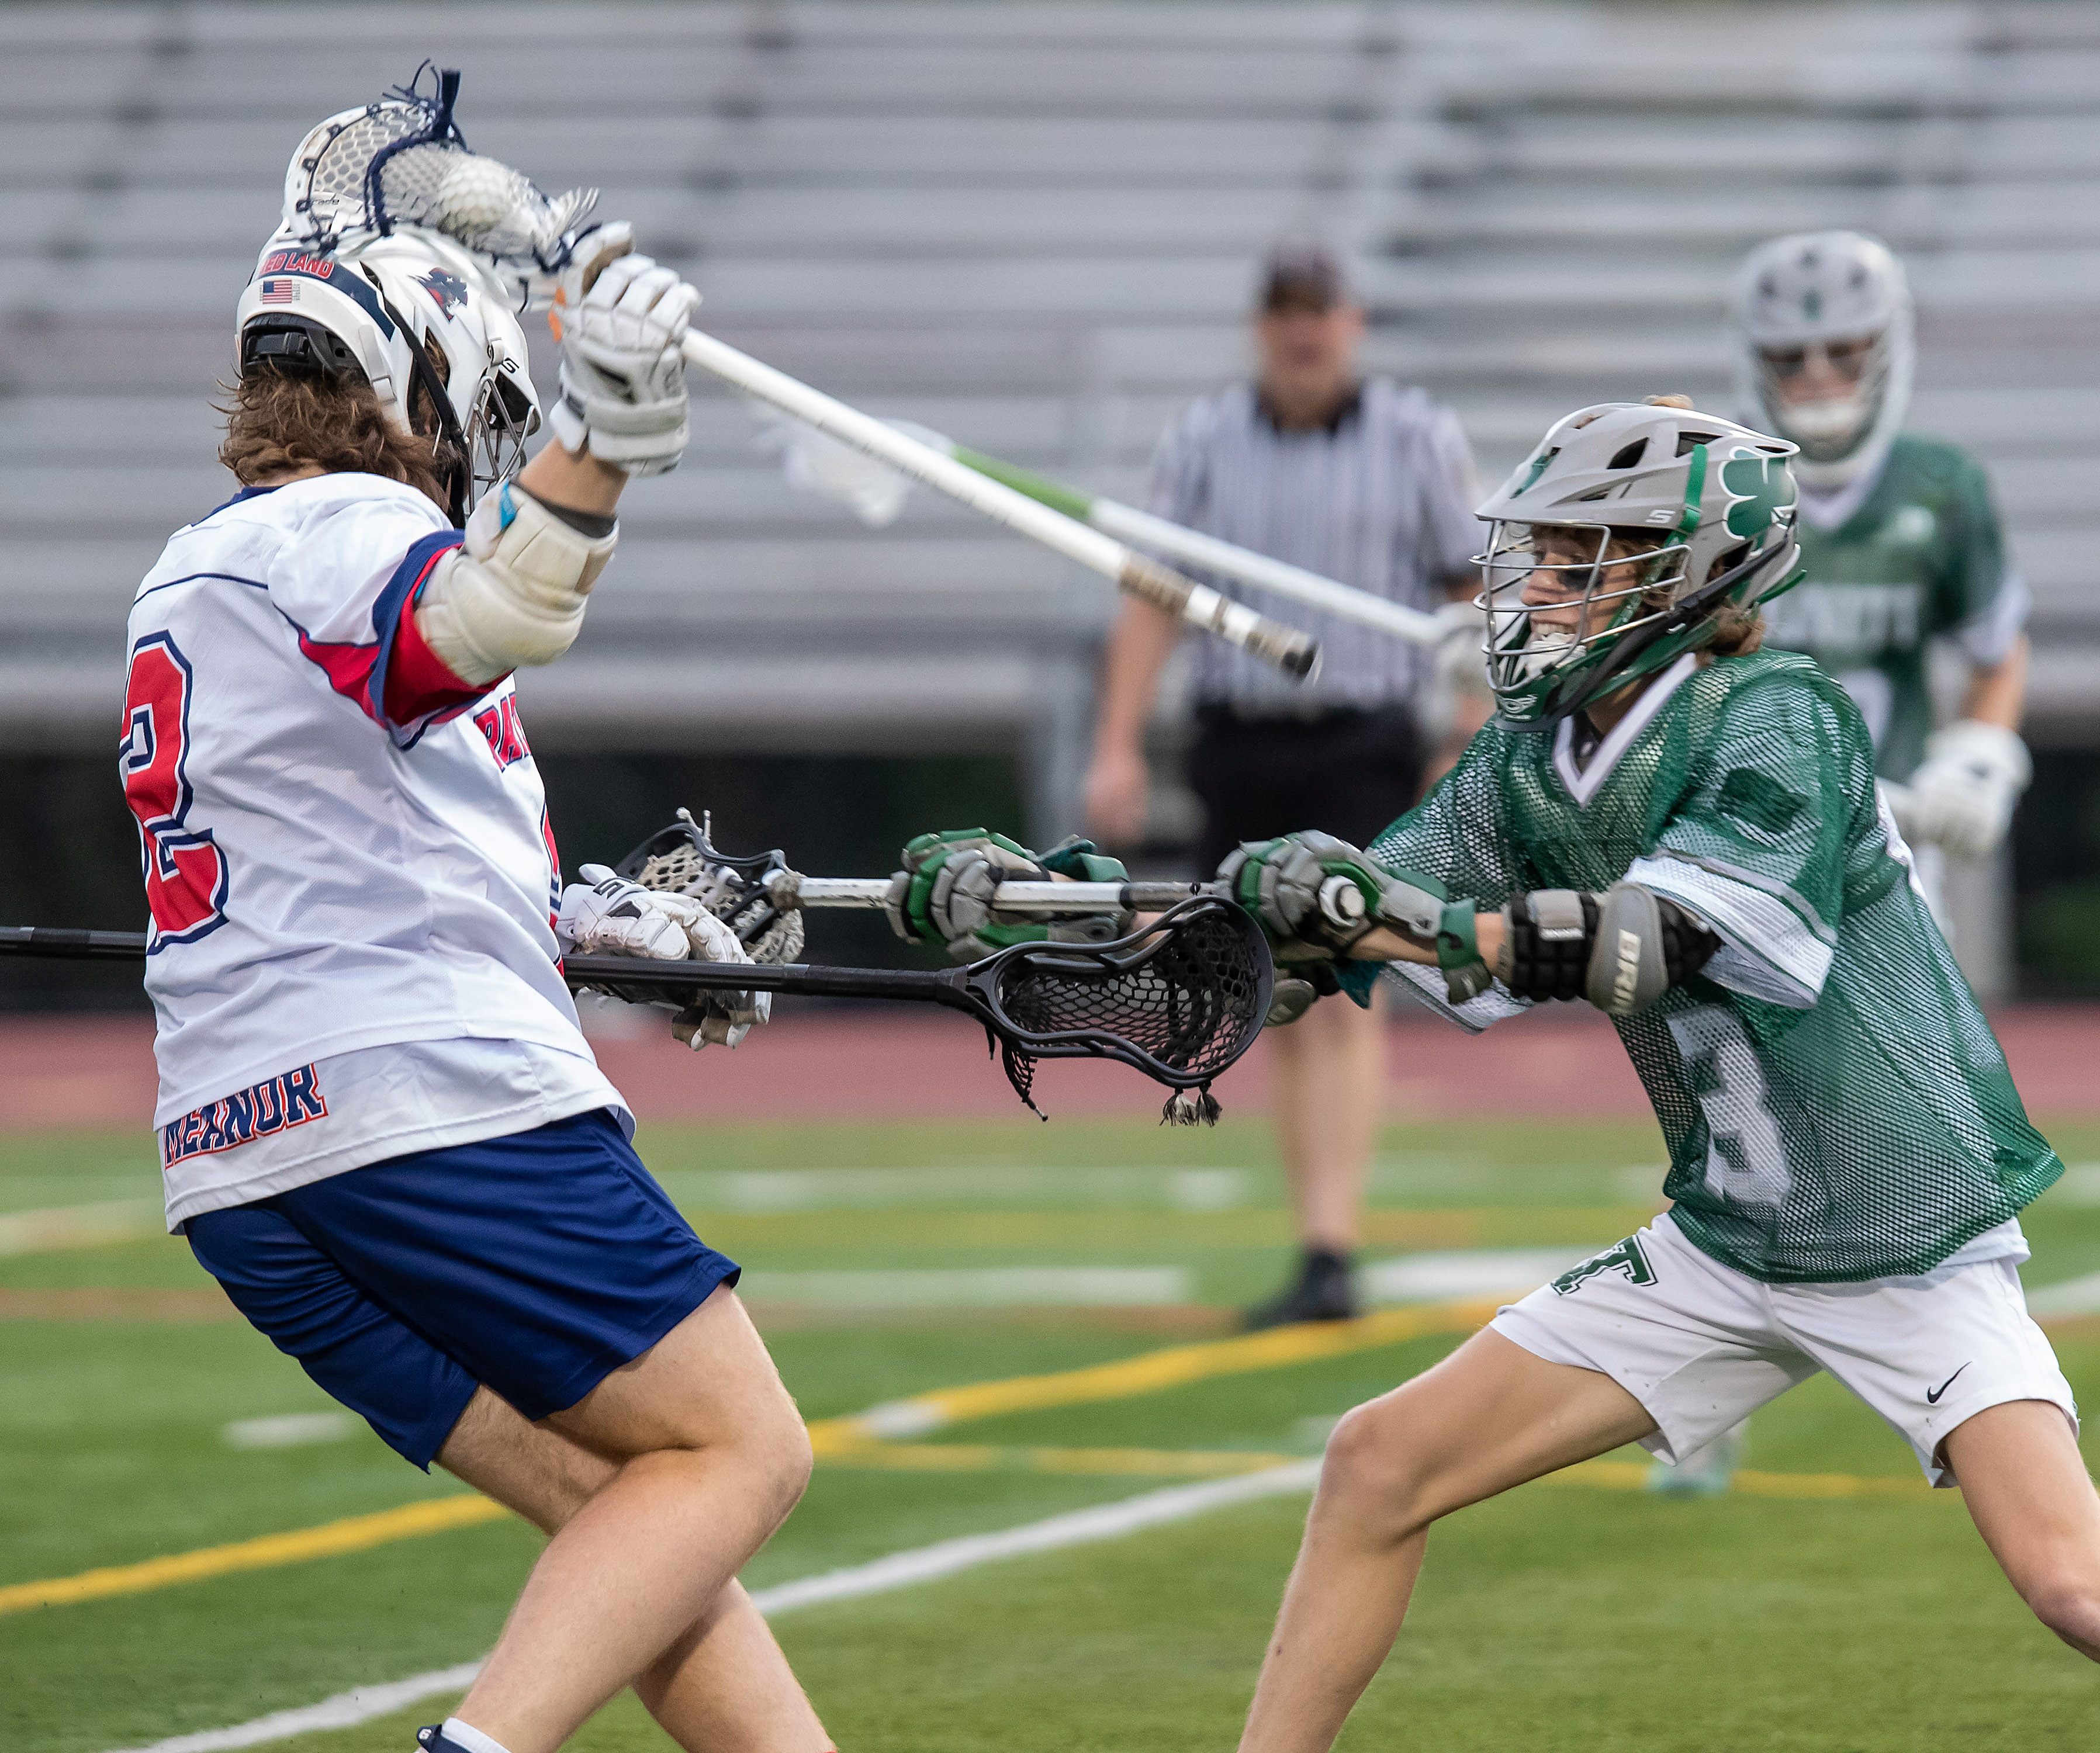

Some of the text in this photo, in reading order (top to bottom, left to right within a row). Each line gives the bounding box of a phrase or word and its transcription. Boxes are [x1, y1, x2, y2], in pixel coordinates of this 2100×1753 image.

[285, 252, 334, 279] LAND
[1645, 509, 1676, 524] S
[1665, 1003, 1792, 1212] 3
